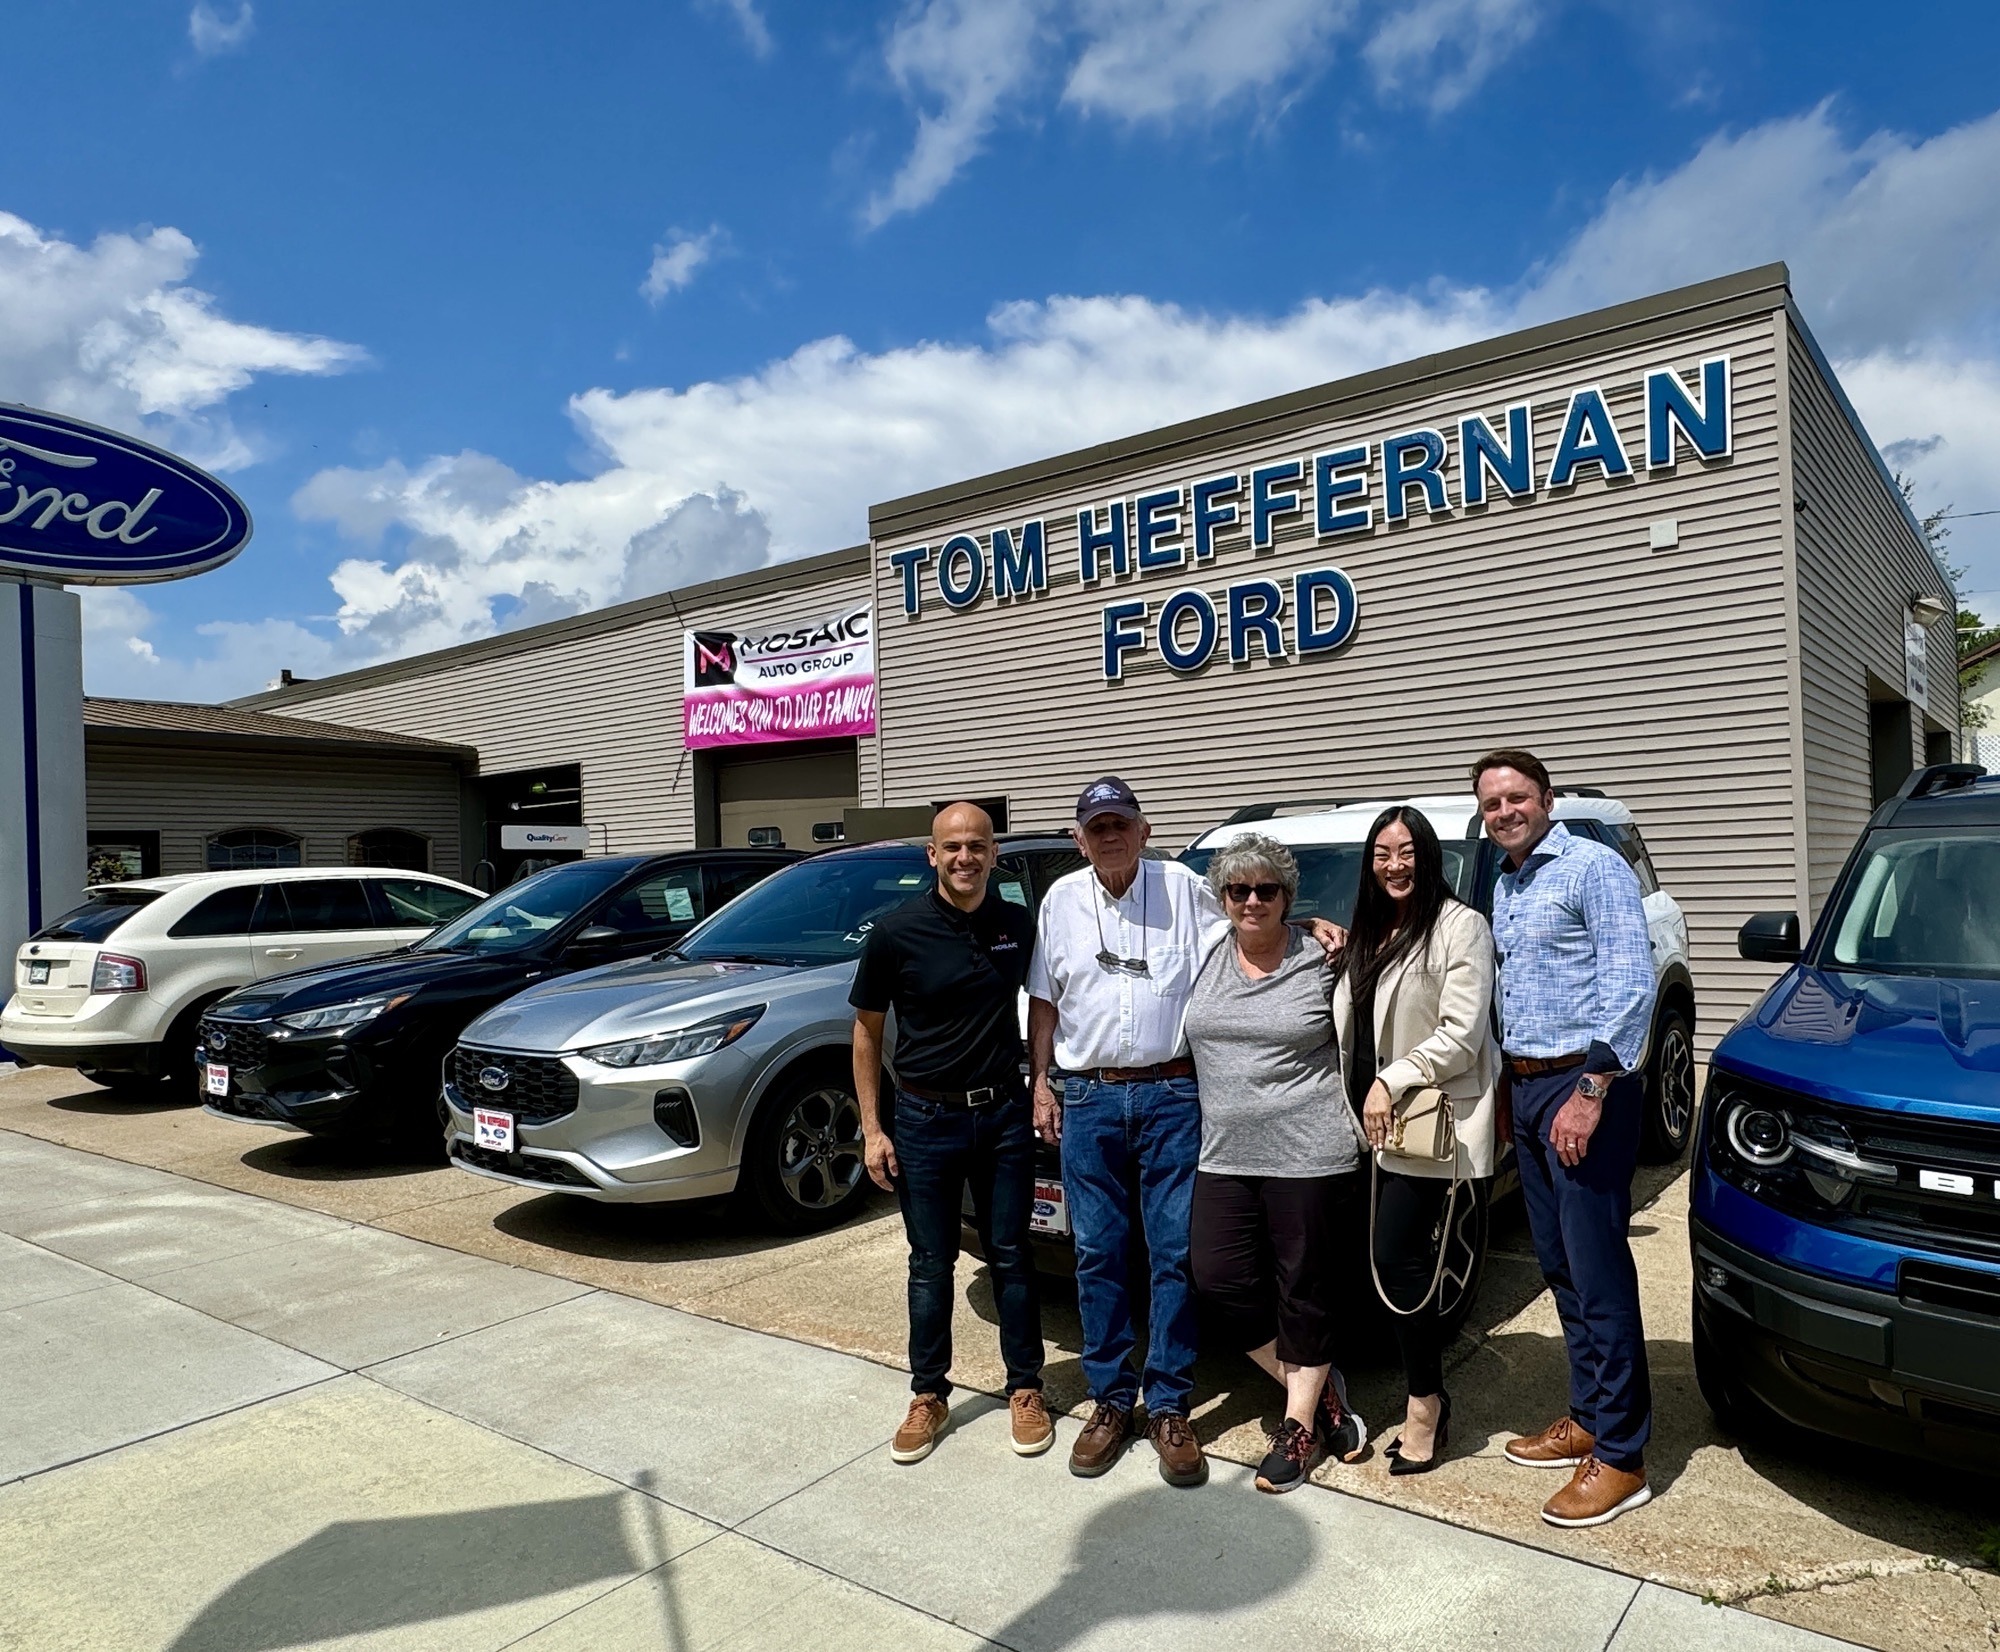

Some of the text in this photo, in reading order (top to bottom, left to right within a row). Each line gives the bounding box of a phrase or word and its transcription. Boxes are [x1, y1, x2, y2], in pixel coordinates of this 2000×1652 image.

[888, 353, 1733, 616] TOM HEFFERNAN
[741, 612, 869, 656] MOSAIC
[1102, 566, 1358, 682] FORD
[758, 652, 853, 679] AUTO GROUP
[688, 699, 749, 737] WELCOMES
[776, 695, 792, 731] TO
[794, 691, 823, 729] OUR
[1919, 1169, 2000, 1200] B
